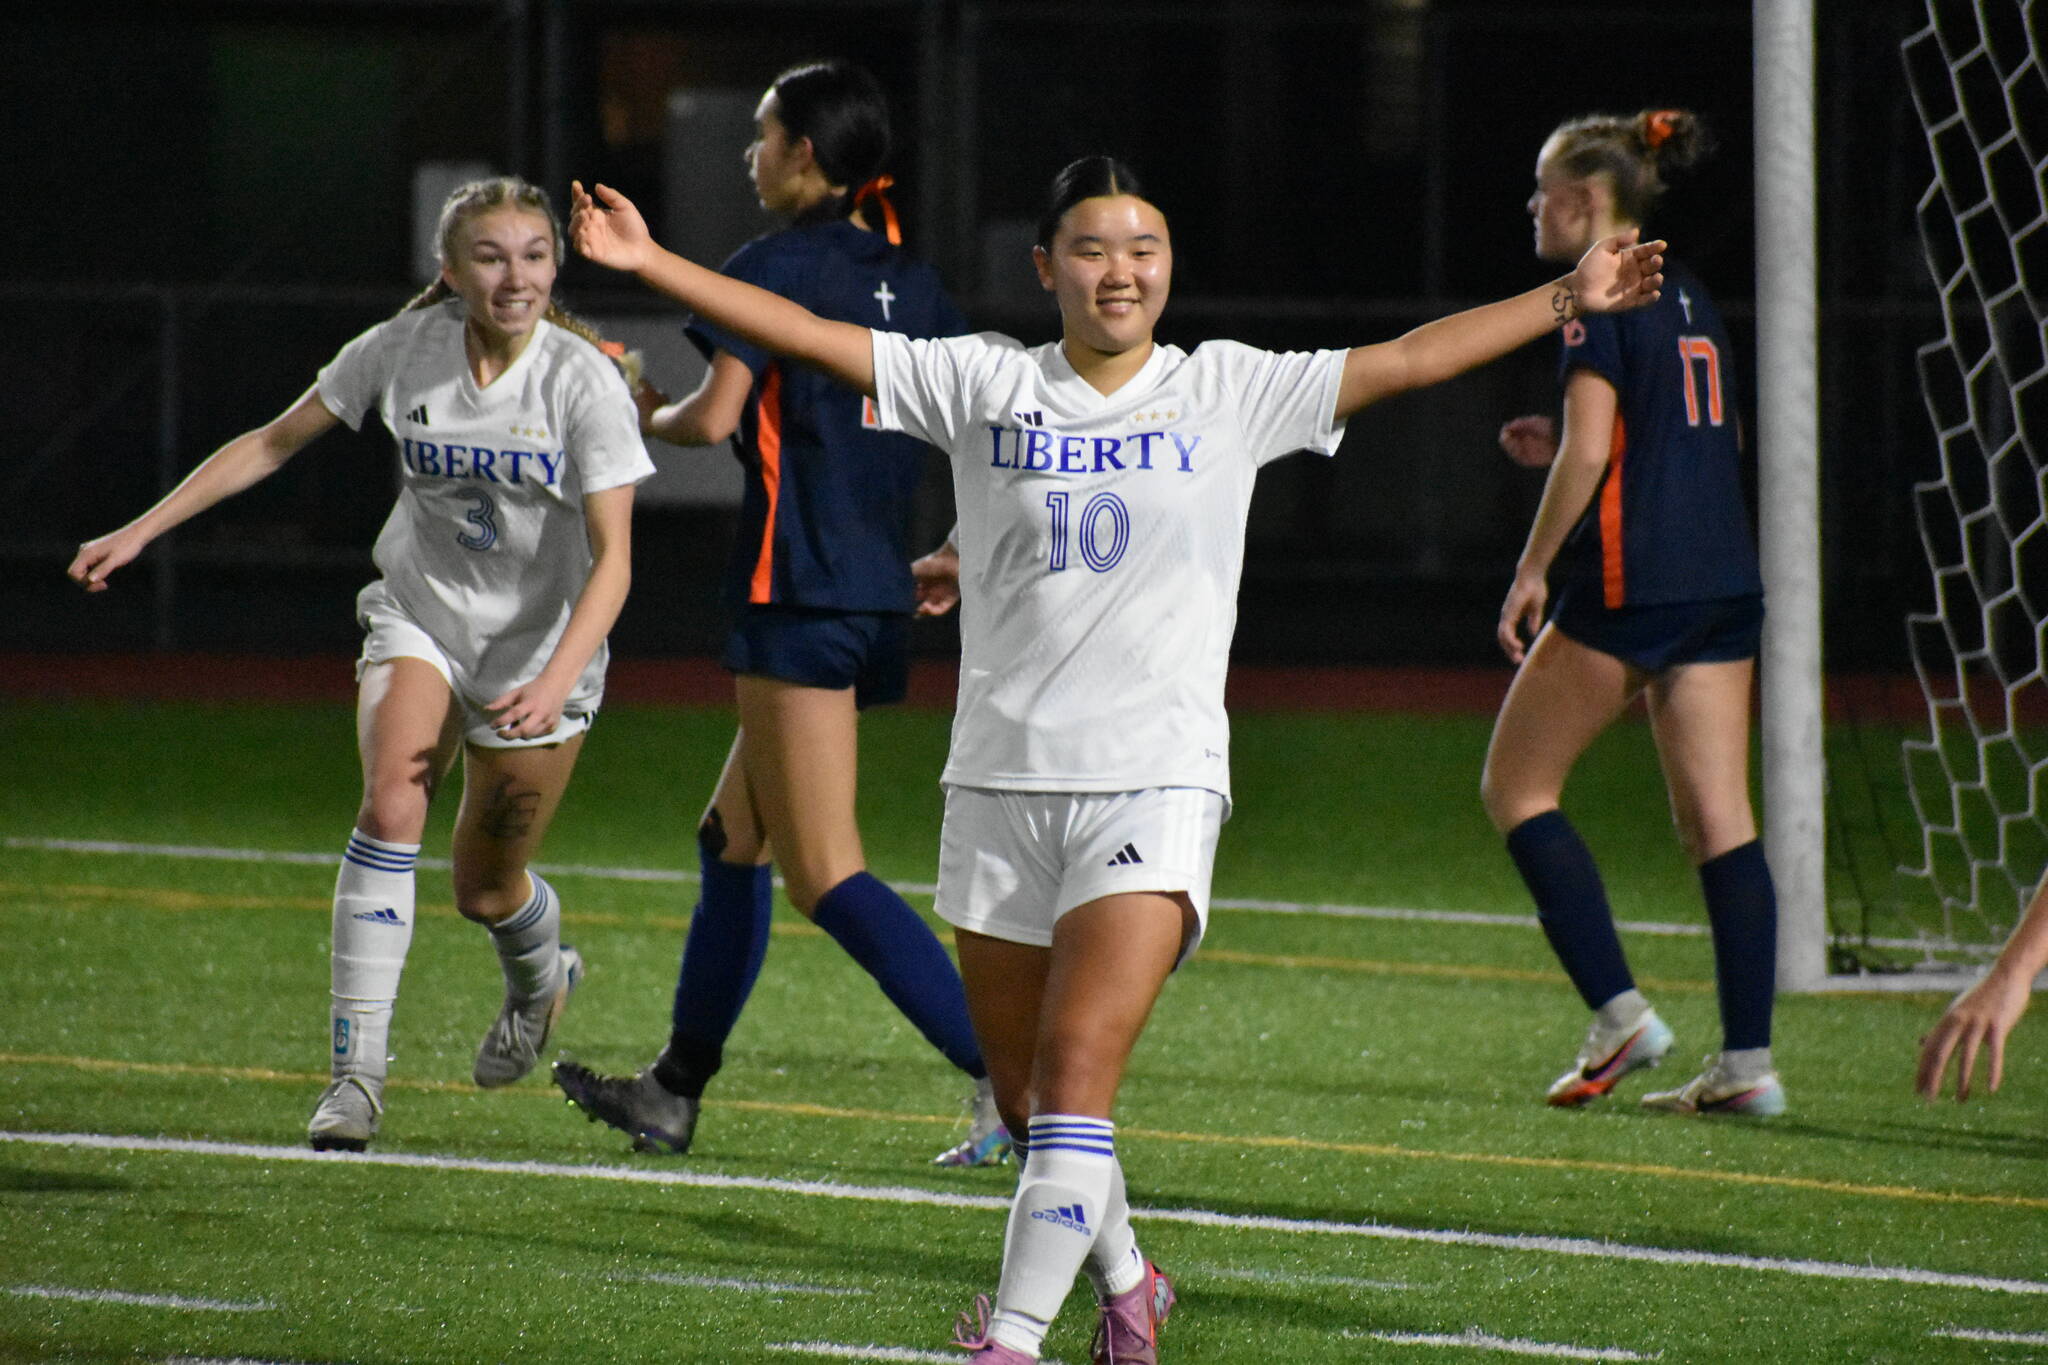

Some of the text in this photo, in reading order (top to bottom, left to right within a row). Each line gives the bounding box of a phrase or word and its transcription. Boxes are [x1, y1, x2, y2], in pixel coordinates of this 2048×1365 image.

[1678, 336, 1723, 427] 17
[403, 437, 563, 486] IBERTY
[989, 425, 1201, 473] LIBERTY
[457, 486, 497, 551] 3
[1046, 491, 1130, 573] 10
[1031, 1208, 1091, 1236] adidas
